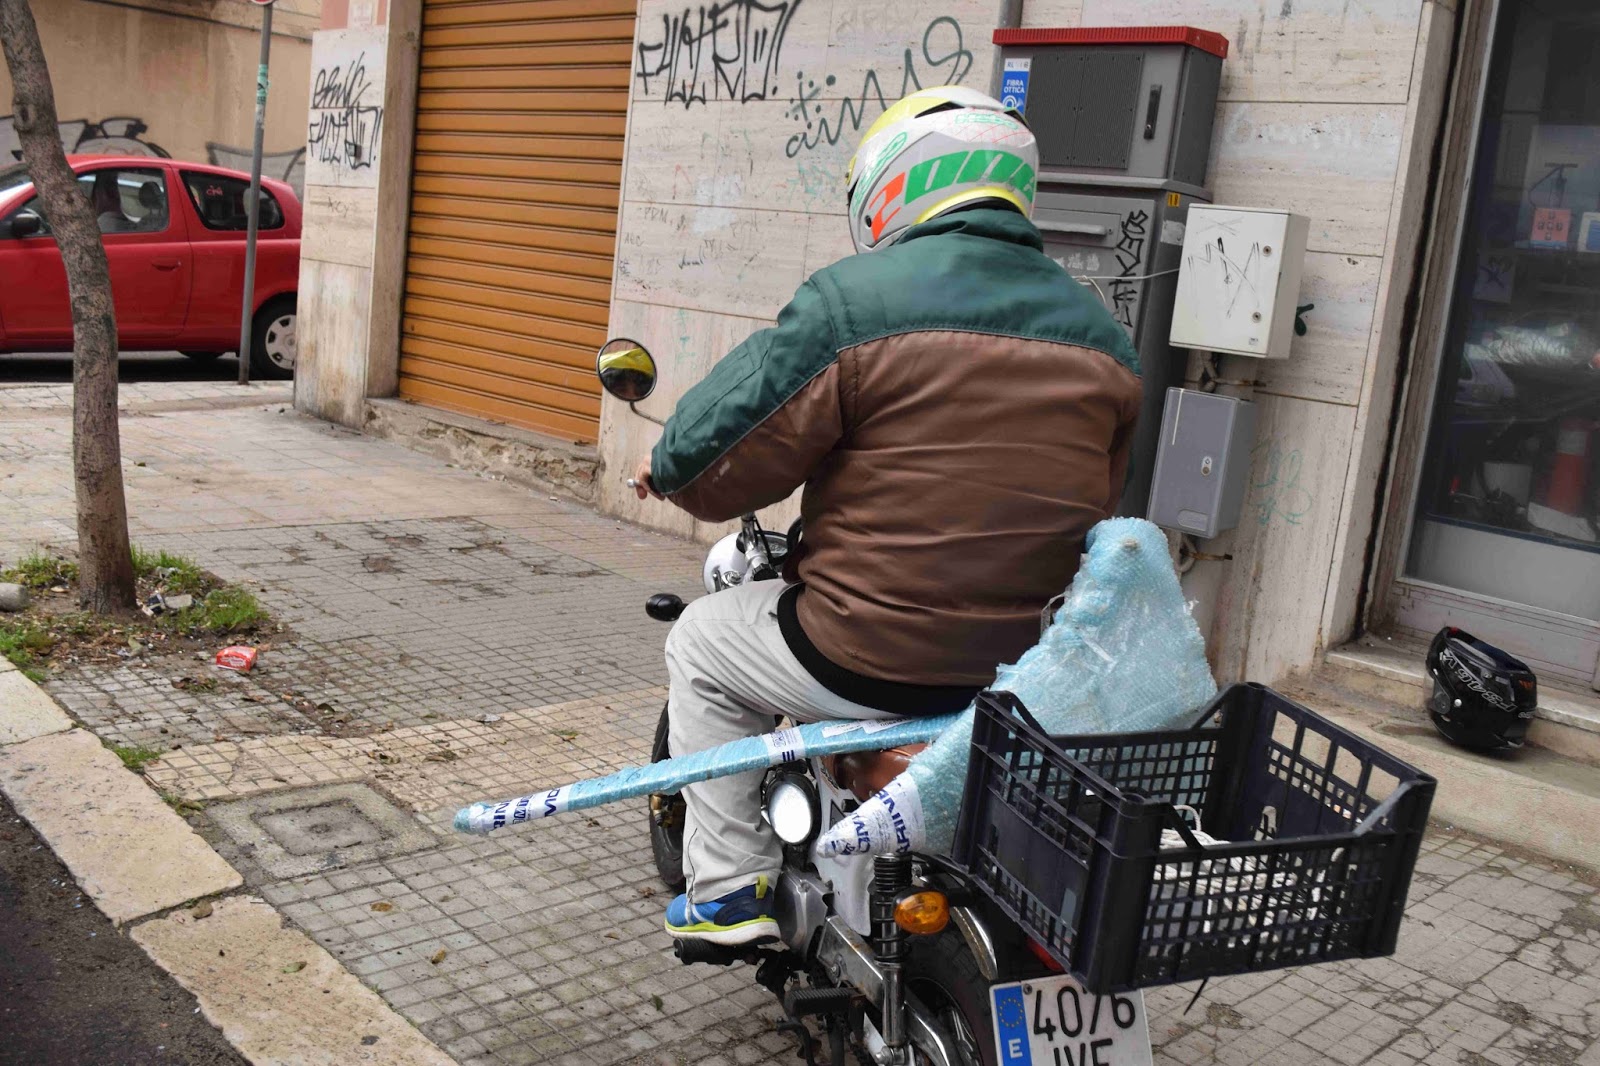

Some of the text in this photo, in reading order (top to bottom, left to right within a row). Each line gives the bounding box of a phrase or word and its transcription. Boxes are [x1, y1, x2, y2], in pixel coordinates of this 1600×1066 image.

[1003, 86, 1026, 94] OTTICA
[1006, 79, 1025, 87] FIBRA
[1033, 986, 1136, 1041] 4076
[1008, 1038, 1023, 1059] E
